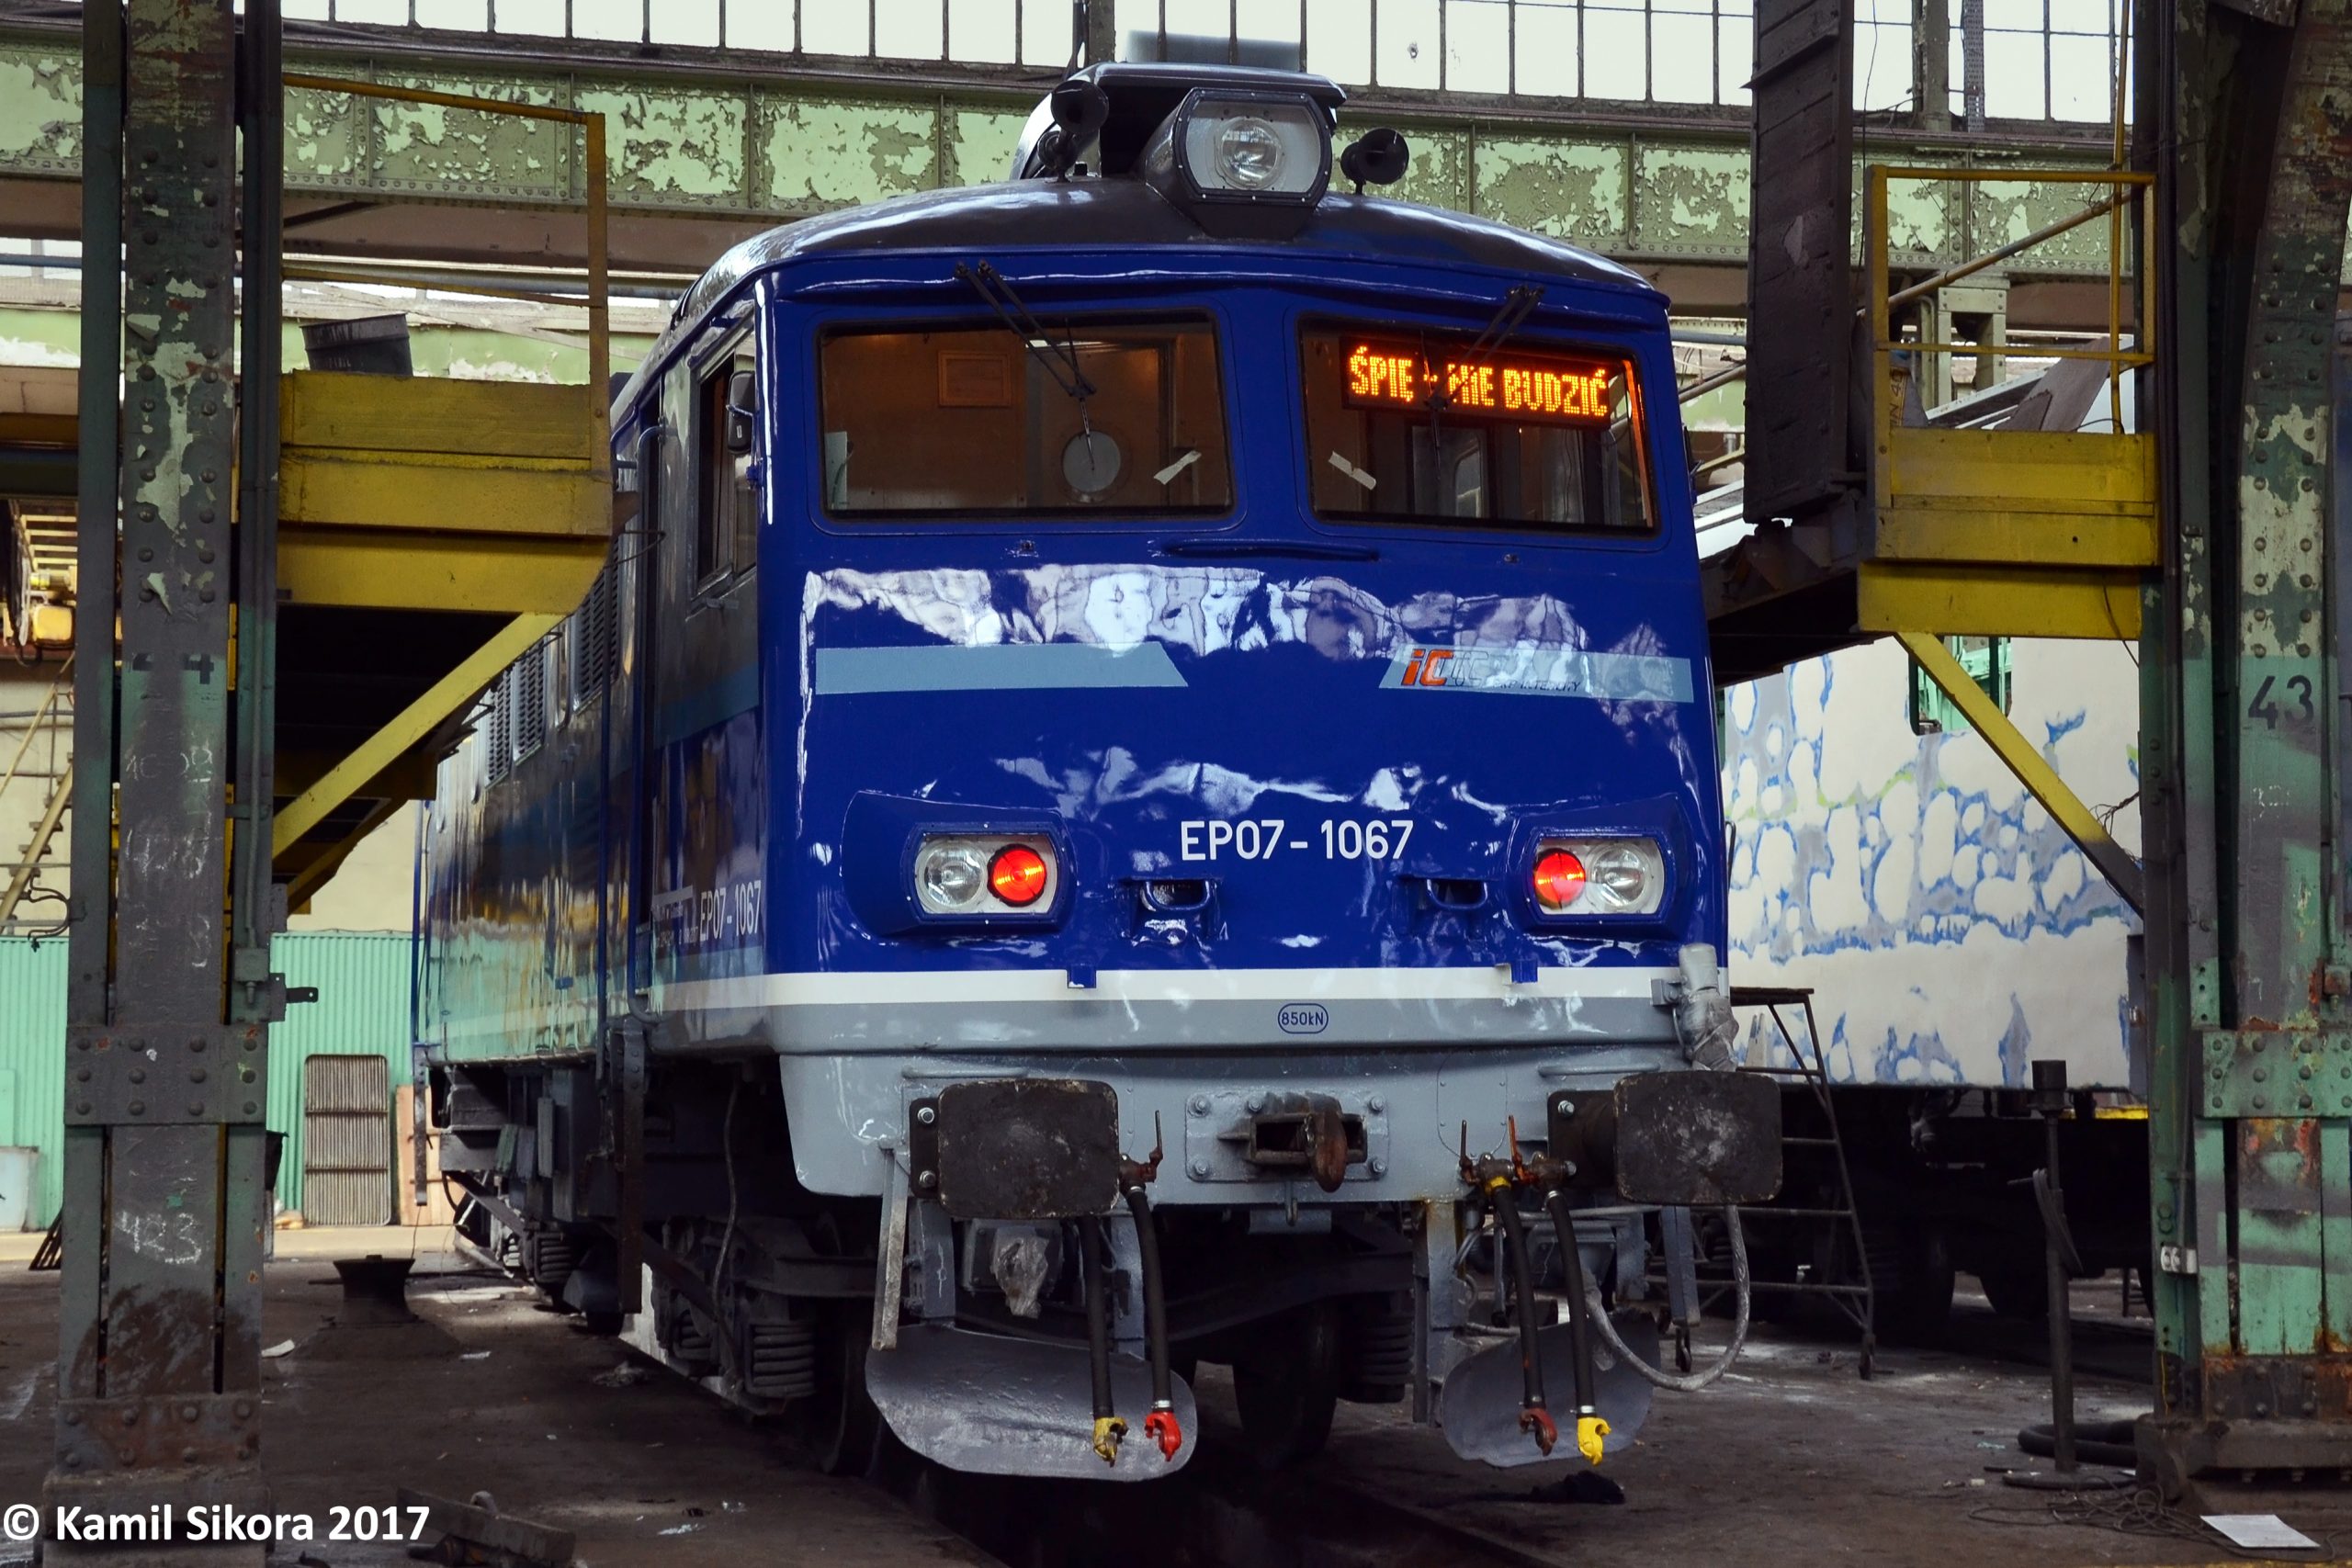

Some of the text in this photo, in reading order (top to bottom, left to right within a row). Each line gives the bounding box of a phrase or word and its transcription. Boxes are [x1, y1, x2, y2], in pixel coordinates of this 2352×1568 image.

[1350, 345, 1414, 402] ŚPIĘ
[1447, 363, 1495, 407] NIE
[1503, 368, 1608, 417] BUDZIĆ
[2248, 674, 2314, 730] 43
[1281, 1011, 1324, 1026] 850kN
